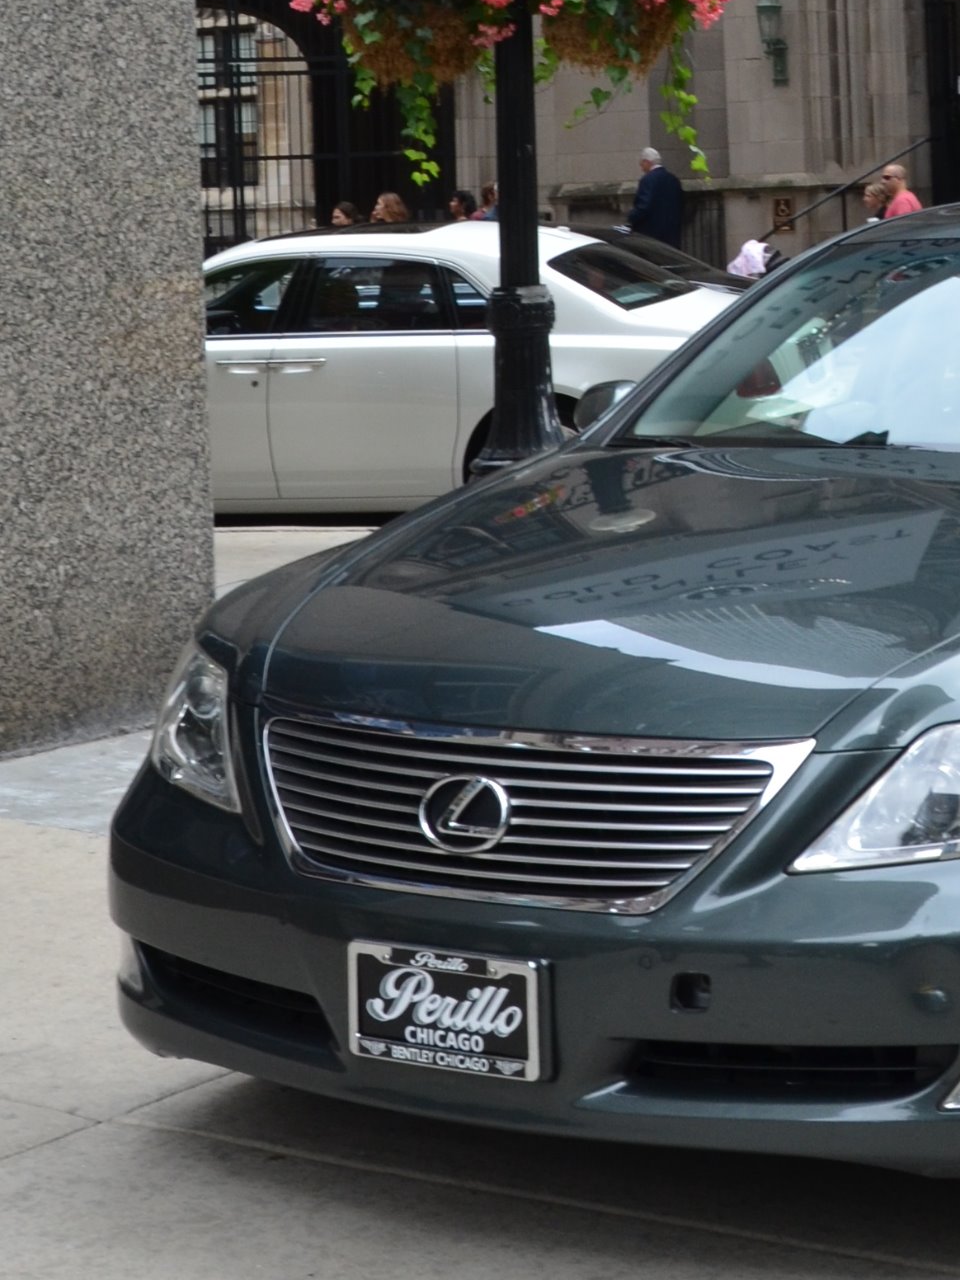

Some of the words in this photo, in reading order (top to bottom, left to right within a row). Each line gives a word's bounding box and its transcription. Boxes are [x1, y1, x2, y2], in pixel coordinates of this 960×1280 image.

[409, 951, 469, 972] Perillo
[366, 967, 523, 1038] Perillo
[404, 1025, 485, 1053] CHICAGO
[391, 1044, 435, 1063] BENTLEY
[434, 1051, 490, 1072] CHICAGO
